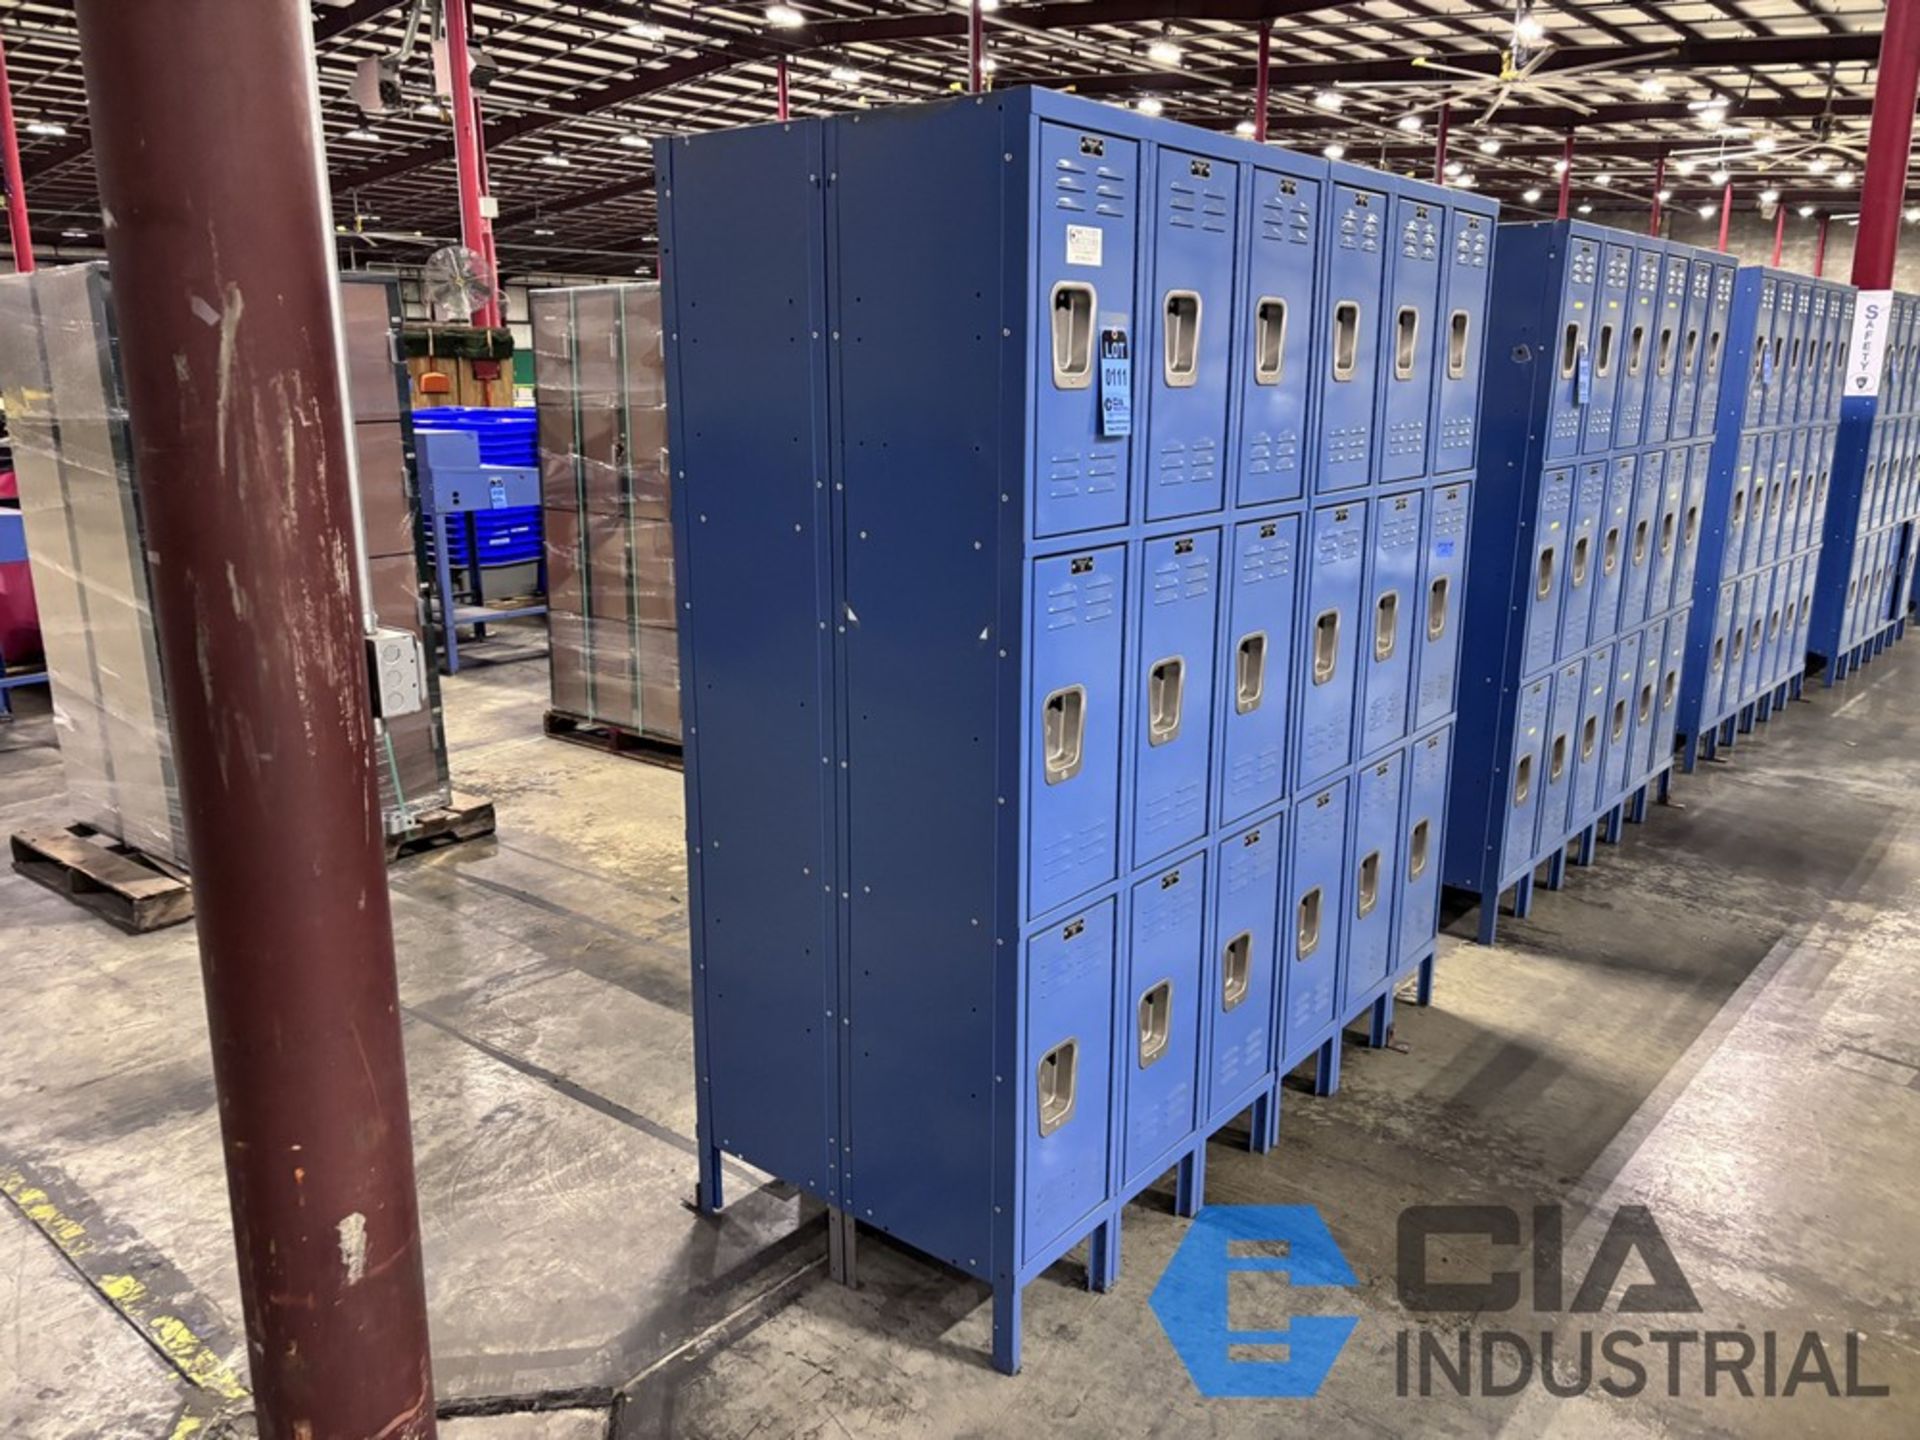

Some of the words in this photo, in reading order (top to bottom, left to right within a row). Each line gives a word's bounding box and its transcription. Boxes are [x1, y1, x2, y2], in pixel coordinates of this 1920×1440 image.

[1860, 304, 1879, 371] SAFETY
[1105, 342, 1126, 358] LOT
[1105, 367, 1128, 386] 0111
